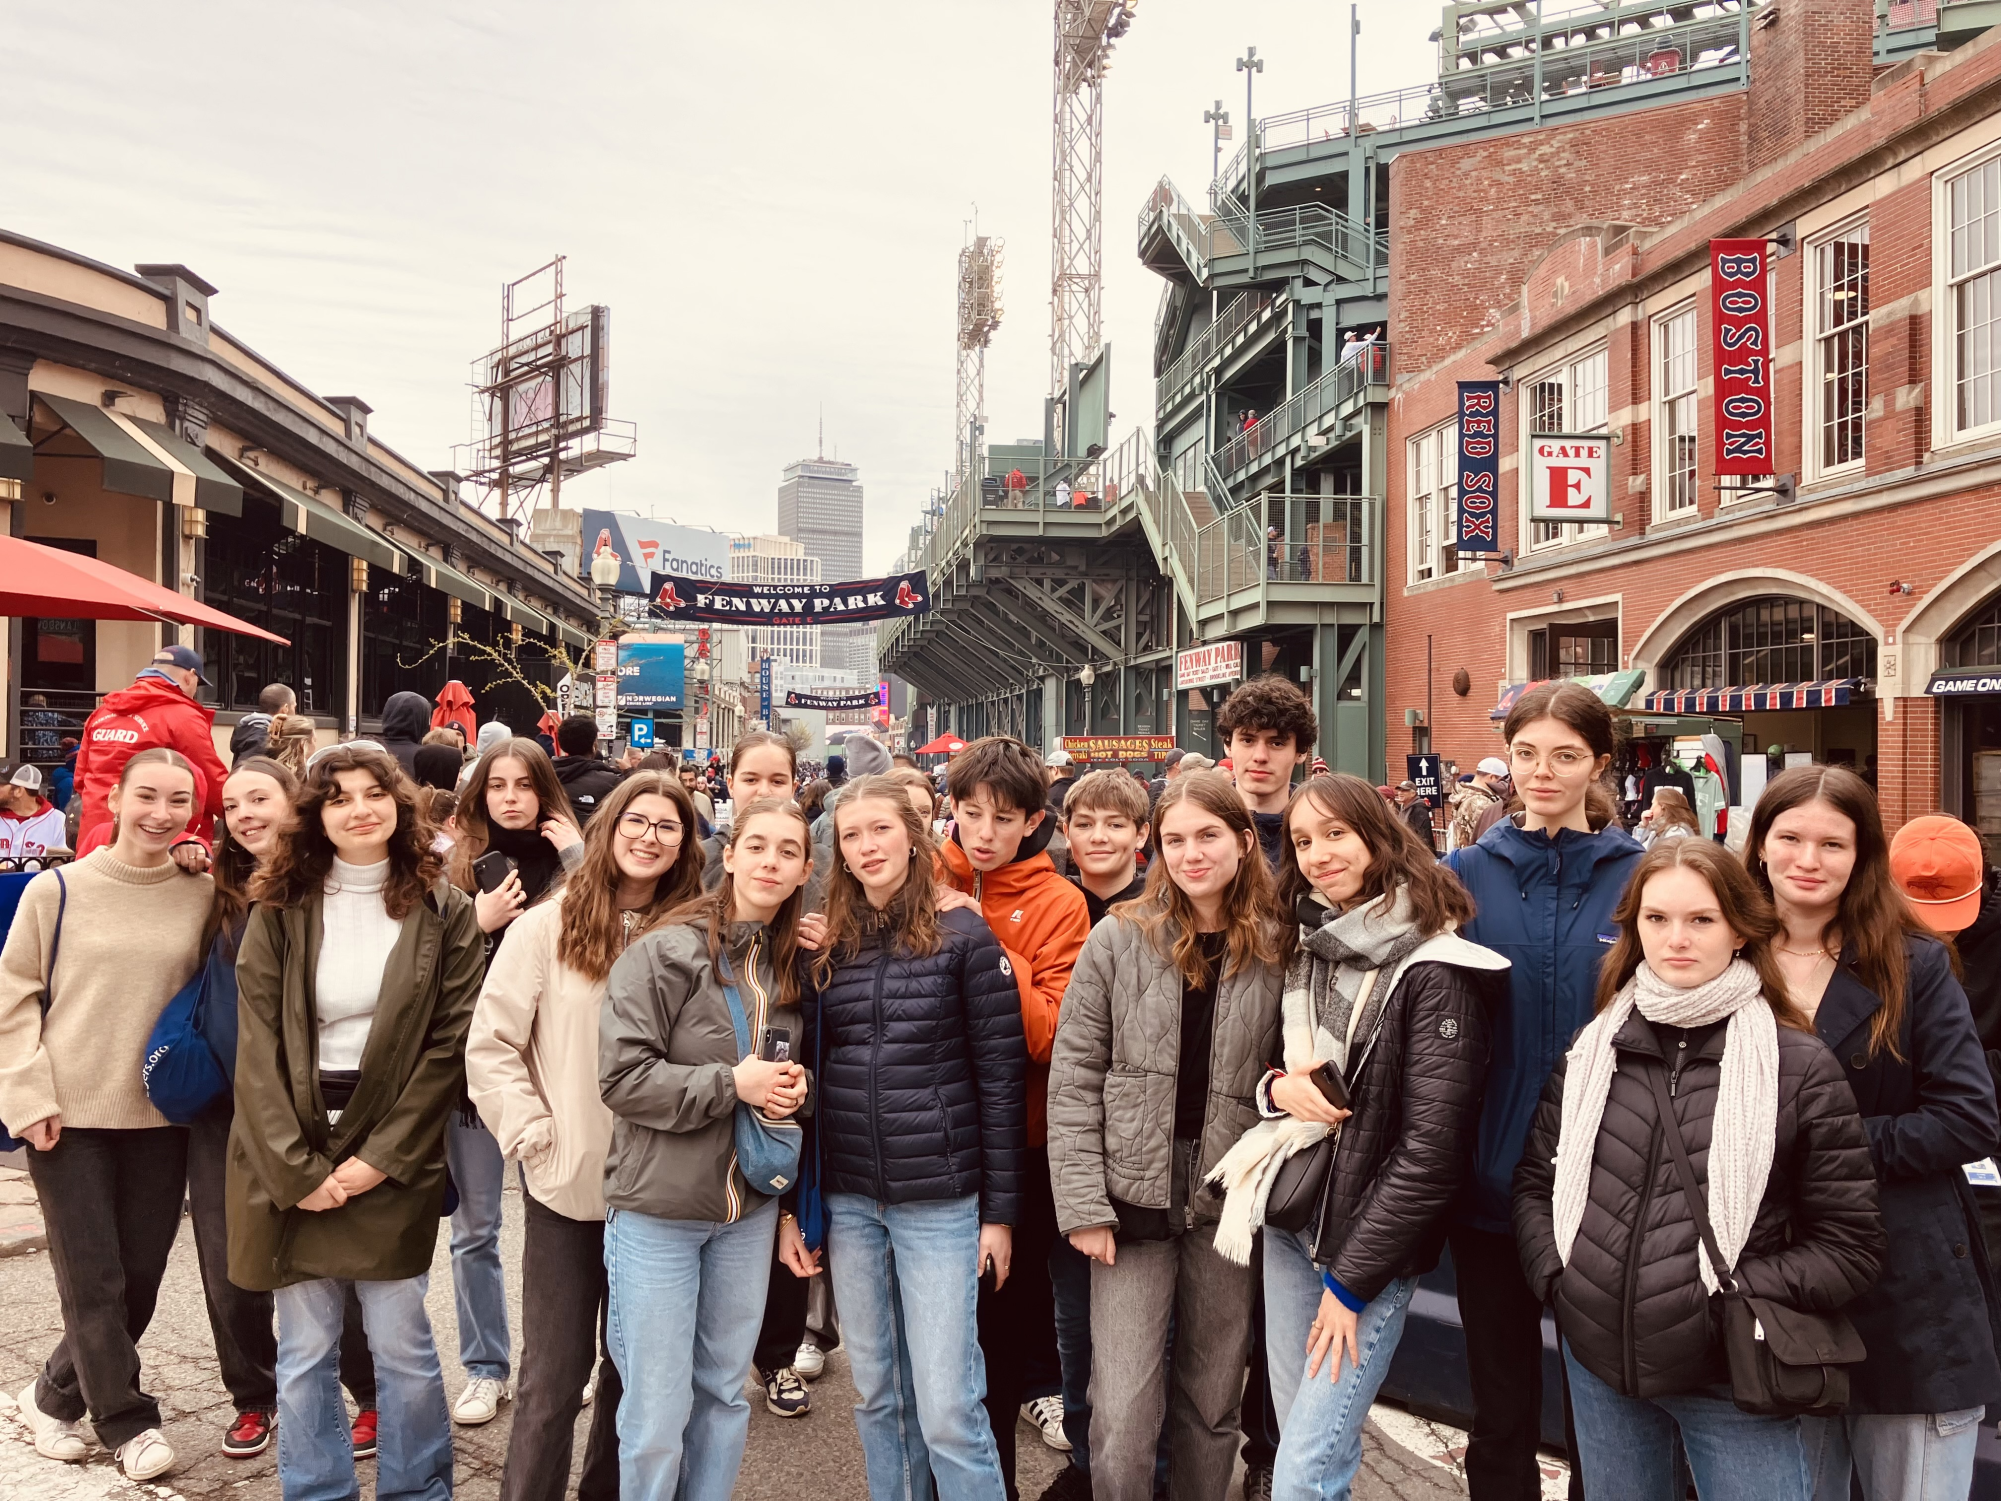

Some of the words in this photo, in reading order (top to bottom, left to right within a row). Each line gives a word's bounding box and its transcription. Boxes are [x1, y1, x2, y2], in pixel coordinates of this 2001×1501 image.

[1718, 253, 1765, 459] BOSTON
[1463, 391, 1494, 458] RED
[1538, 445, 1601, 459] GATE
[1545, 466, 1592, 509] E
[1462, 472, 1494, 541] SOX
[662, 550, 723, 579] Fanatics
[753, 585, 811, 594] WELCOME
[815, 585, 830, 593] TO
[696, 593, 810, 613] FENWAY
[813, 591, 887, 612] PARK
[1179, 648, 1213, 672] FENWAY
[1214, 641, 1241, 665] PARK
[762, 662, 770, 698] HOUSE
[1932, 680, 1977, 693] GAME
[1976, 678, 2001, 692] ON
[801, 698, 839, 707] FENWAY
[840, 698, 866, 707] PARK
[92, 728, 139, 744] GUARD
[634, 724, 648, 741] P
[1064, 739, 1088, 749] Chicken
[1089, 739, 1149, 752] SAUSAGES
[1151, 738, 1173, 749] Steak
[1153, 751, 1167, 760] TIP
[1415, 777, 1435, 786] EXIT
[1416, 786, 1438, 796] HERE
